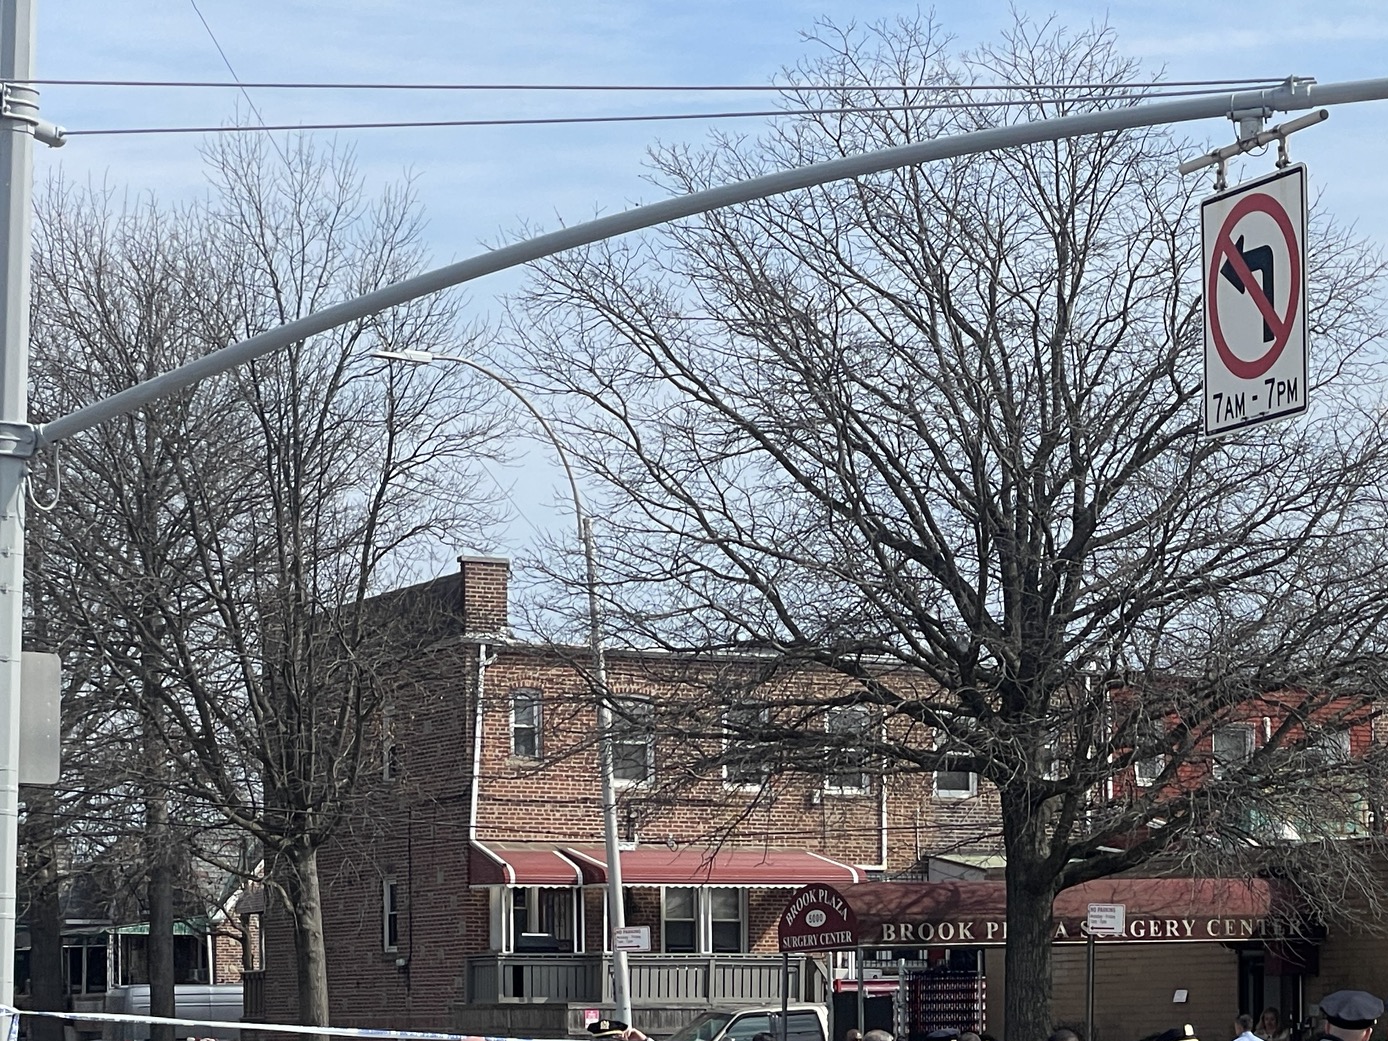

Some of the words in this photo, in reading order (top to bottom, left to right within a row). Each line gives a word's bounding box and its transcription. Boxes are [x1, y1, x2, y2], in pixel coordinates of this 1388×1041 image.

[1213, 392, 1246, 423] 7AM
[1265, 377, 1298, 409] 7PM
[785, 889, 817, 926] BROOK
[818, 889, 848, 921] PLAZA
[782, 933, 819, 948] SURGERY
[820, 930, 852, 945] CENTER
[882, 921, 975, 941] BROOK
[1080, 919, 1196, 938] SGERY
